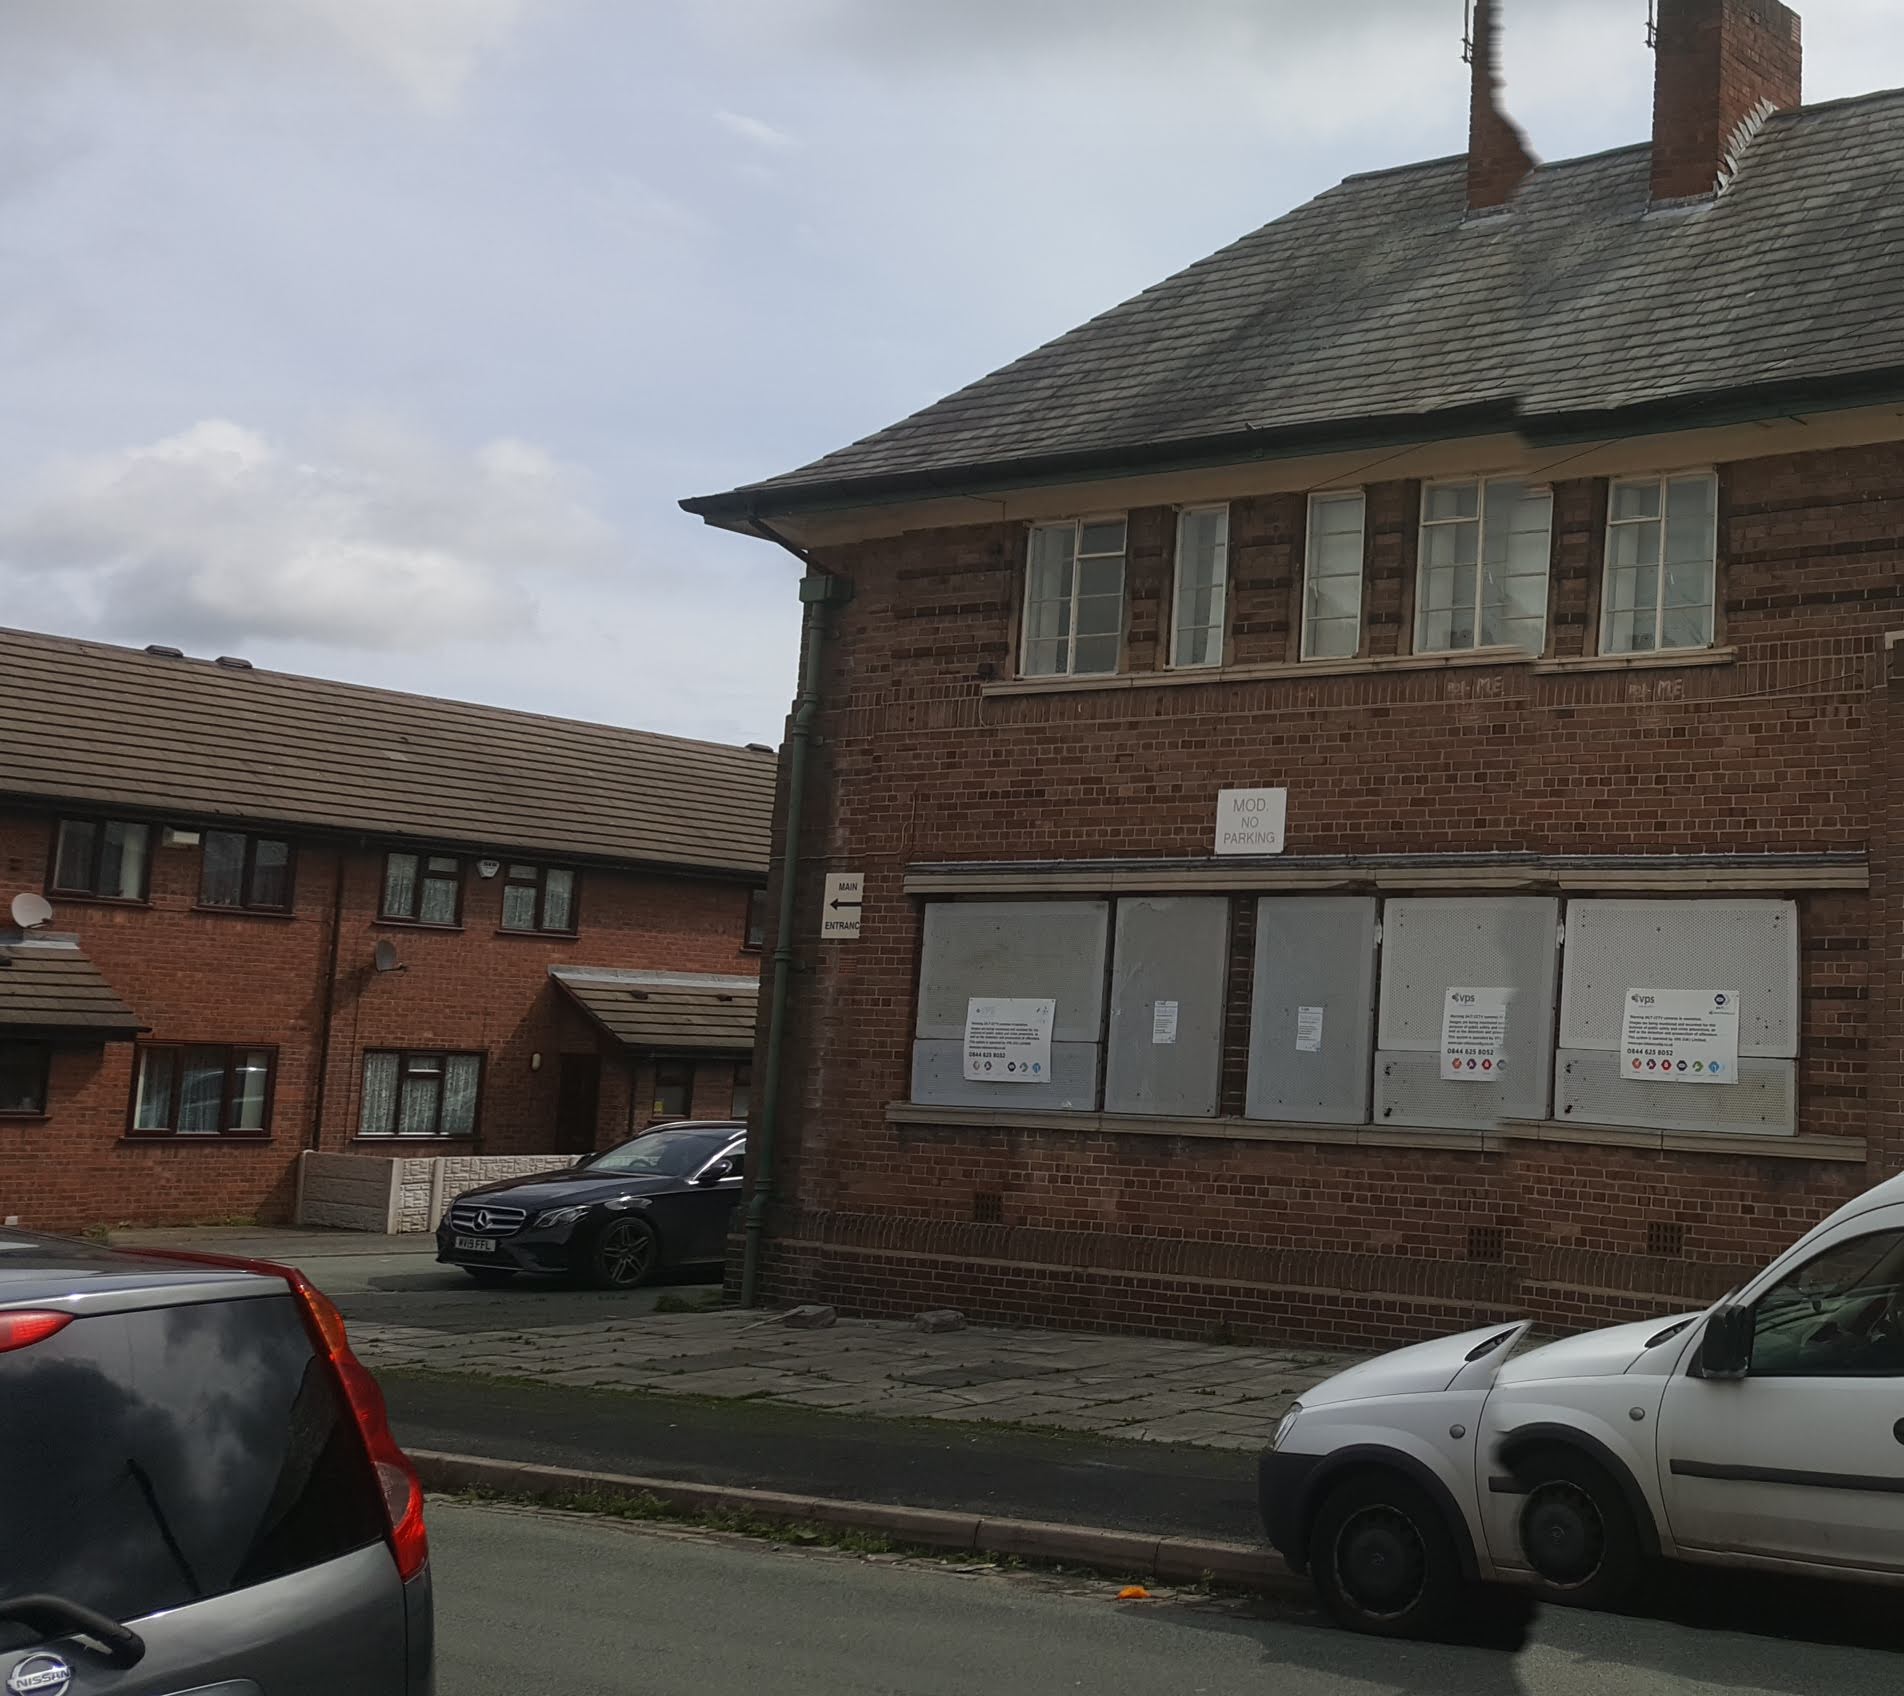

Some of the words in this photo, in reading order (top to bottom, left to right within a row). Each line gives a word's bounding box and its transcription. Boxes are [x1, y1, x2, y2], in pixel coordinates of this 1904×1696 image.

[1241, 816, 1259, 829] NO
[1223, 832, 1276, 845] PARKING
[838, 882, 858, 891] MAIN
[16, 1670, 70, 1688] NISSAN
